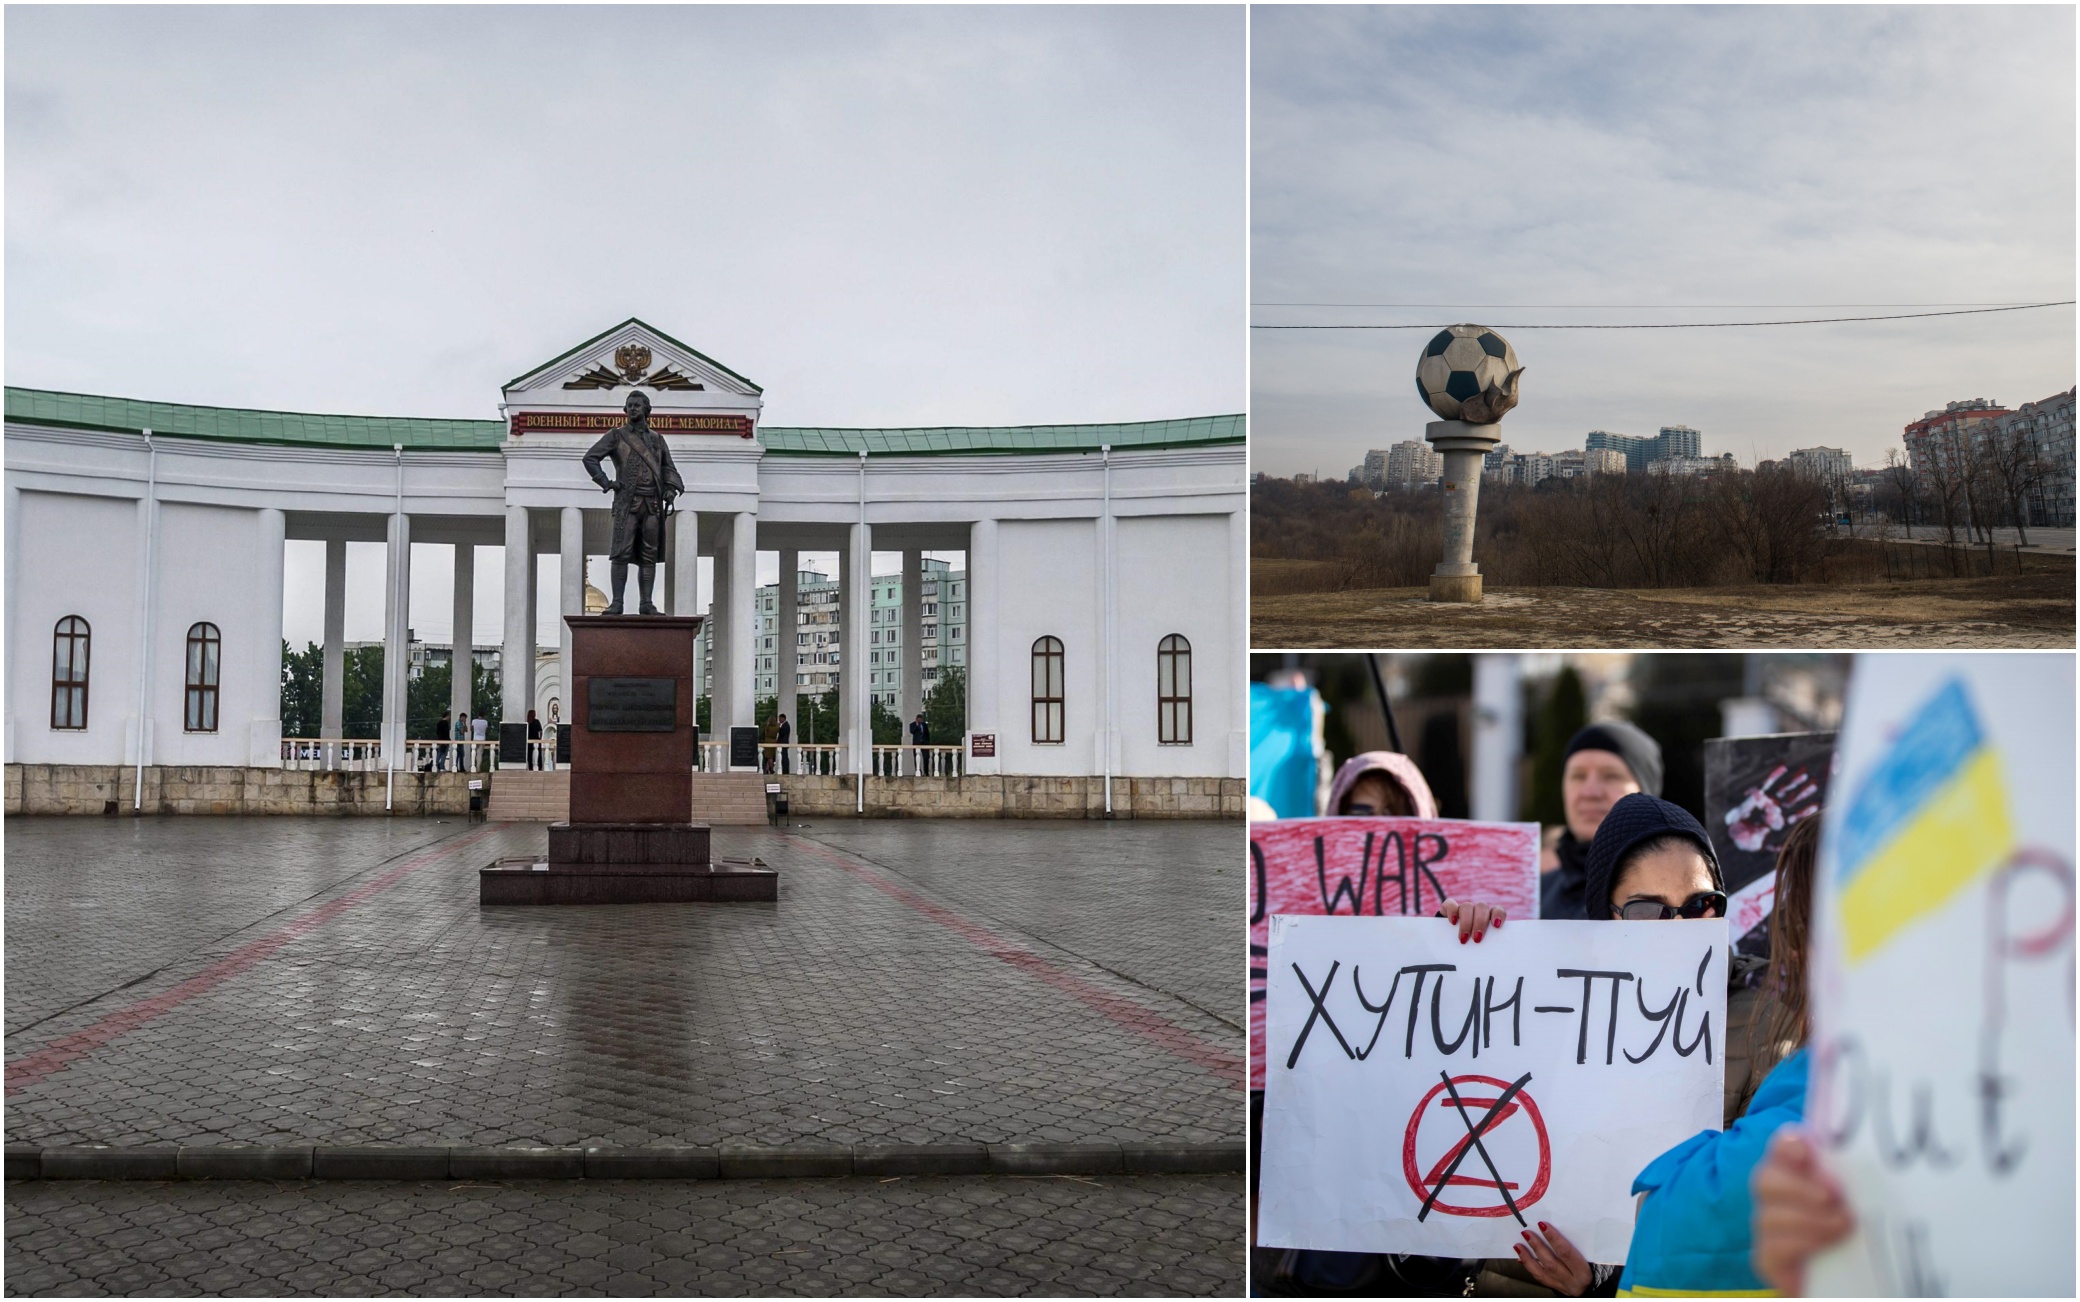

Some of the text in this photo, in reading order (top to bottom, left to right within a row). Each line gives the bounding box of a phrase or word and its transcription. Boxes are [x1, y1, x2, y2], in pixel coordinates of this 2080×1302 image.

[527, 414, 738, 430] ВОЕННЫЙ ИСТОРИКИЙ МЕМОРИАЛ
[1313, 830, 1449, 916] WAR
